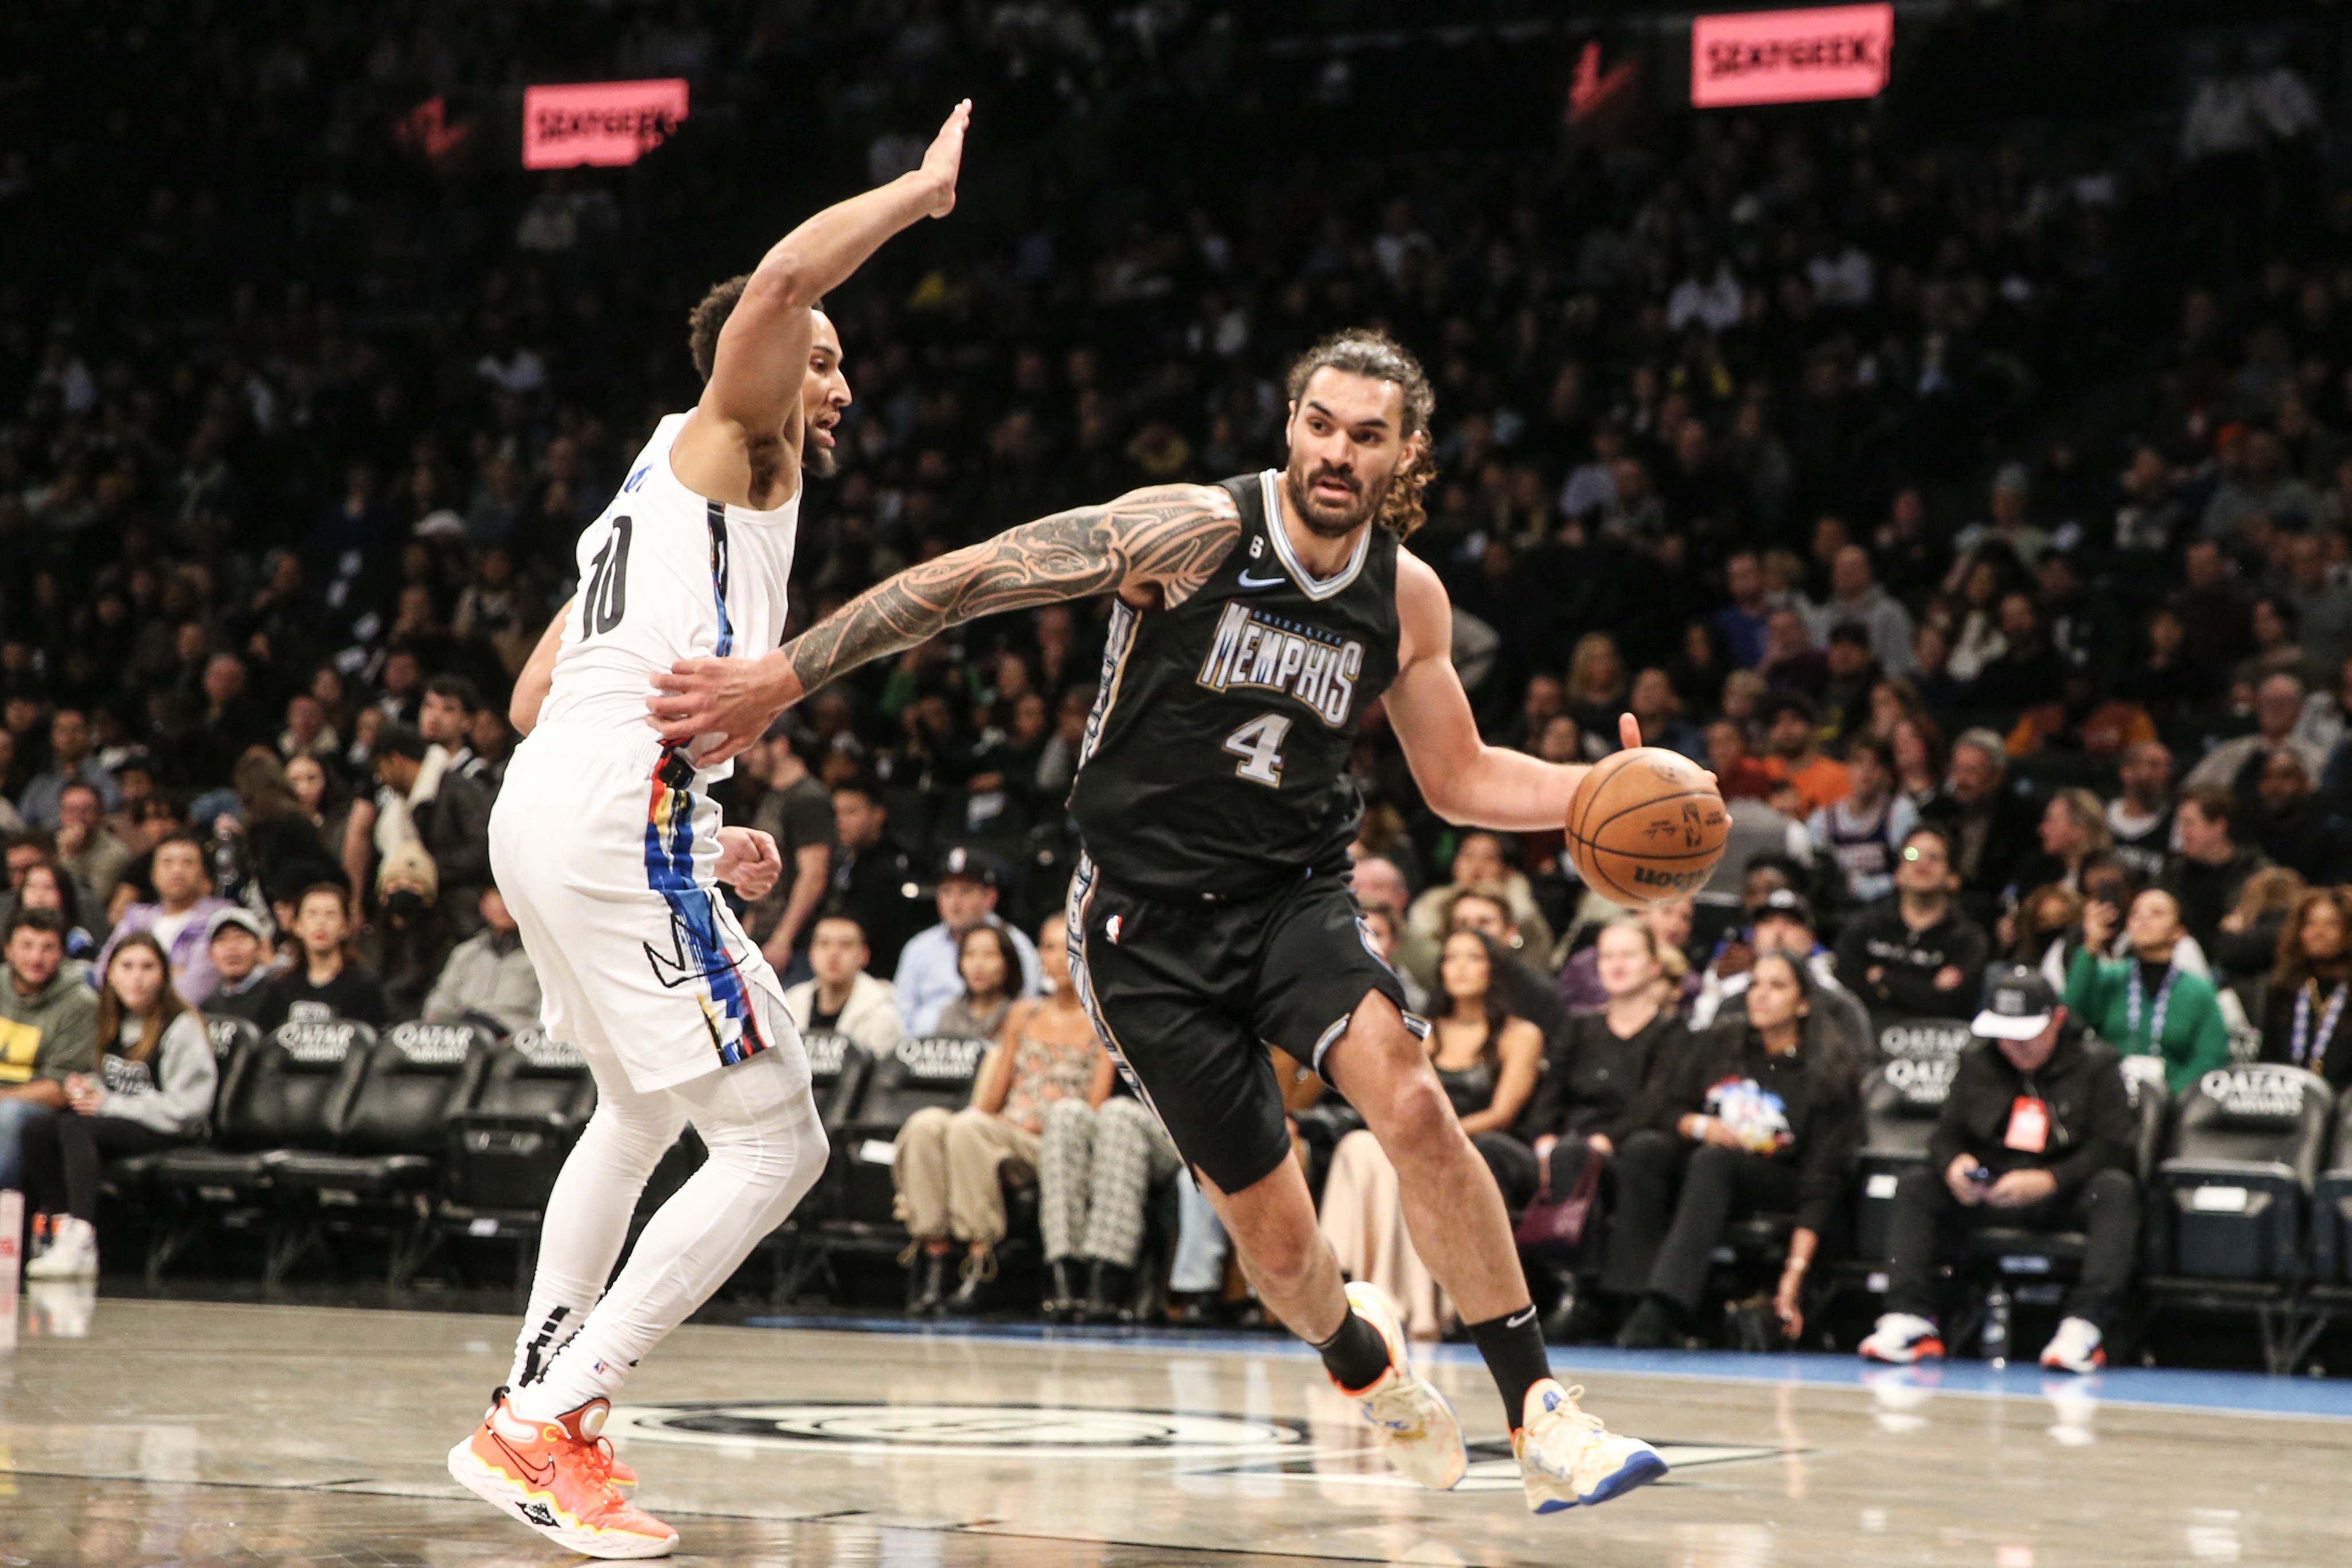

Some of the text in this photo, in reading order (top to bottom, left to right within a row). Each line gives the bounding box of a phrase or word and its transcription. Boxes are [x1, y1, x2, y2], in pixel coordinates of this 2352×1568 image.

[1249, 535, 1264, 559] 6
[579, 516, 633, 642] 10
[1197, 600, 1365, 727] MEMPHIS
[1222, 712, 1293, 788] 4
[392, 1022, 474, 1051] QATAR
[896, 1037, 982, 1063] QATAR
[2200, 1069, 2305, 1100] QATAR
